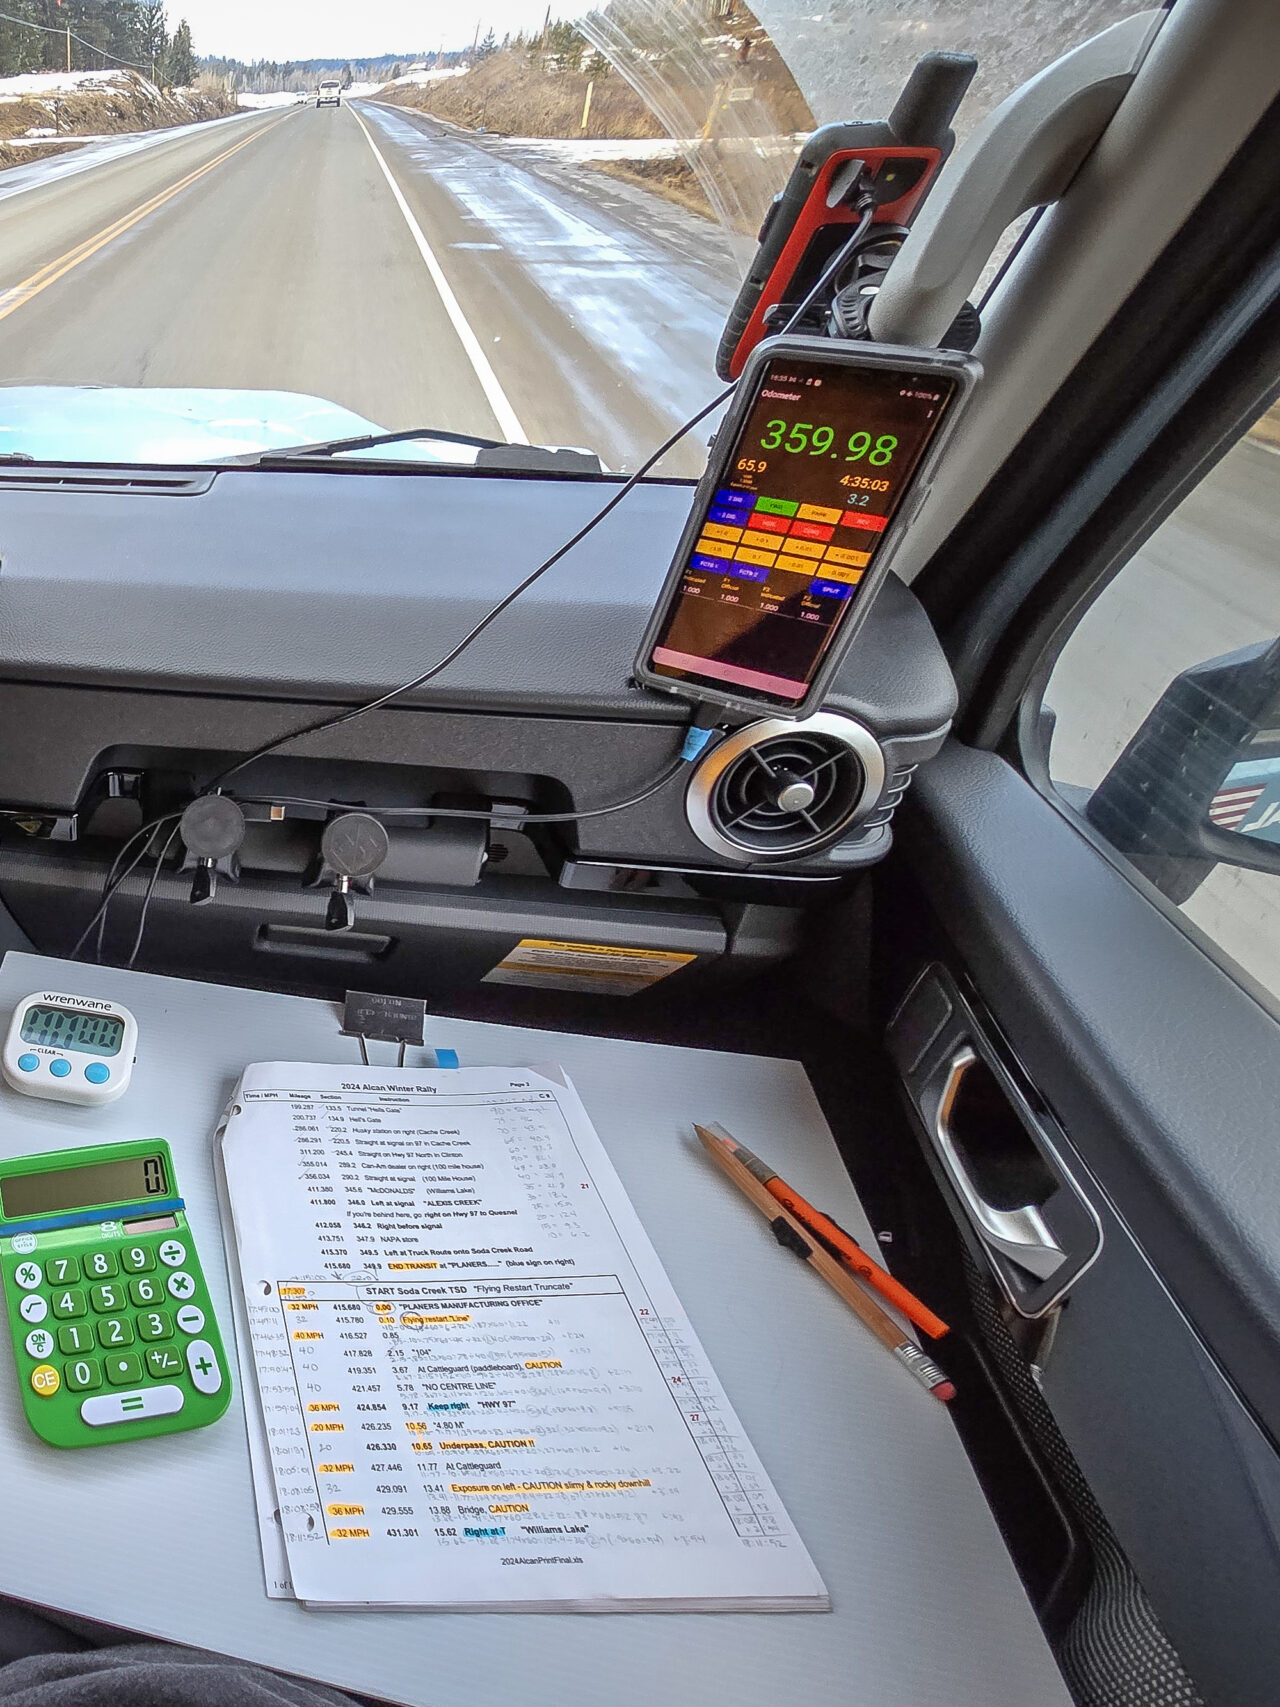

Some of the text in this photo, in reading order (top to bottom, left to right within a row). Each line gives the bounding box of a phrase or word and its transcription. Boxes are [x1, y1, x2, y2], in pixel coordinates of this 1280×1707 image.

[761, 389, 802, 401] Odometer
[760, 419, 898, 466] 359.98
[737, 458, 768, 473] 65.9
[839, 474, 890, 492] 4:35:03
[847, 494, 870, 507] 3.2
[801, 611, 820, 621] 1.000
[43, 993, 112, 1011] wrenwane
[37, 1048, 56, 1056] CLEAR
[363, 1083, 386, 1091] Alcan
[421, 1223, 443, 1231] signal
[93, 1254, 108, 1273] 8
[131, 1248, 145, 1267] 9
[21, 1265, 36, 1283] %
[55, 1260, 67, 1280] 7
[139, 1279, 153, 1300] 6
[398, 1287, 420, 1295] Soda
[421, 1287, 447, 1295] Creek
[448, 1286, 467, 1294] TSD
[473, 1285, 501, 1295] "Flying
[503, 1284, 533, 1293] Restart
[534, 1282, 573, 1291] Truncate"
[60, 1292, 74, 1312] 4
[101, 1286, 115, 1307] 5
[441, 1301, 510, 1309] MANUFACTURING
[511, 1300, 543, 1308] OFFICE"
[148, 1314, 163, 1335] 3
[31, 1333, 46, 1343] ON
[69, 1328, 80, 1348] 1
[108, 1321, 123, 1342] 2
[36, 1344, 44, 1353] C
[299, 1346, 314, 1354] 40
[75, 1362, 90, 1385] 0
[303, 1363, 319, 1371] 40
[427, 1365, 469, 1374] Cattleguard
[470, 1363, 523, 1373] (paddleboard),
[524, 1361, 562, 1369] CAUTION
[33, 1371, 56, 1388] CE
[307, 1384, 321, 1392] 40
[422, 1383, 439, 1391] "NO
[441, 1382, 473, 1390] CENTRE
[474, 1382, 496, 1390] LINE"
[371, 1464, 403, 1472] 427.446
[417, 1463, 437, 1471] 11.77
[445, 1462, 456, 1470] At
[458, 1461, 501, 1471] Cattleguard
[326, 1484, 342, 1493] 32
[381, 1507, 413, 1515] 429.555
[429, 1506, 450, 1514] 13.88
[458, 1505, 487, 1514] Bridge,
[489, 1504, 529, 1513] CAUTION
[349, 1529, 369, 1537] MPH
[386, 1529, 418, 1537] 431.301
[434, 1528, 457, 1536] 15.62
[464, 1527, 489, 1537] Right
[520, 1525, 562, 1534] "Williams
[565, 1524, 589, 1533] Lake"
[500, 1557, 584, 1565] 2024AlcanPrintFinal.xls
